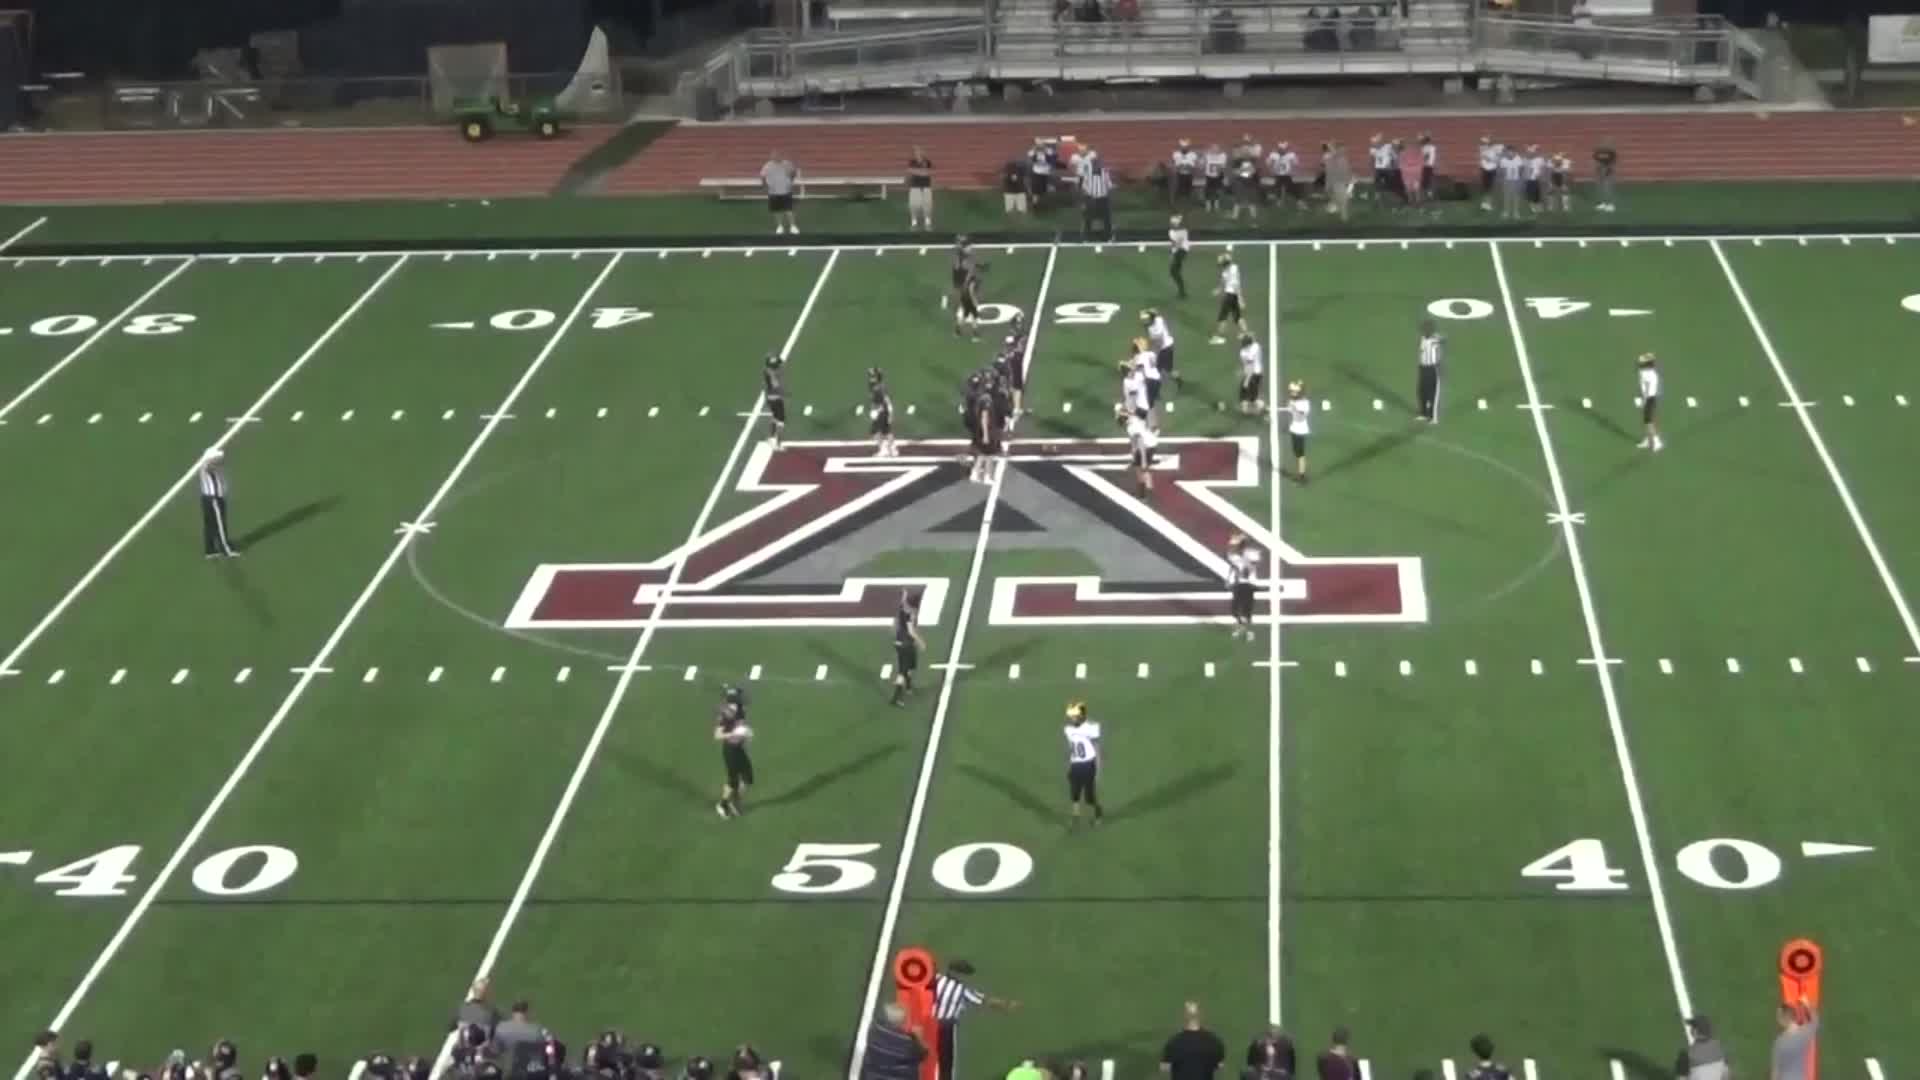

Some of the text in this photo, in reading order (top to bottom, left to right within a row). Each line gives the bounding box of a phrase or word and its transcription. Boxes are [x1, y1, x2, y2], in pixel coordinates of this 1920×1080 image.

[29, 313, 197, 335] 30
[489, 308, 654, 331] 40
[1427, 296, 1592, 319] 40
[34, 844, 299, 896] 40
[771, 841, 1034, 894] 50
[1520, 837, 1782, 891] 40
